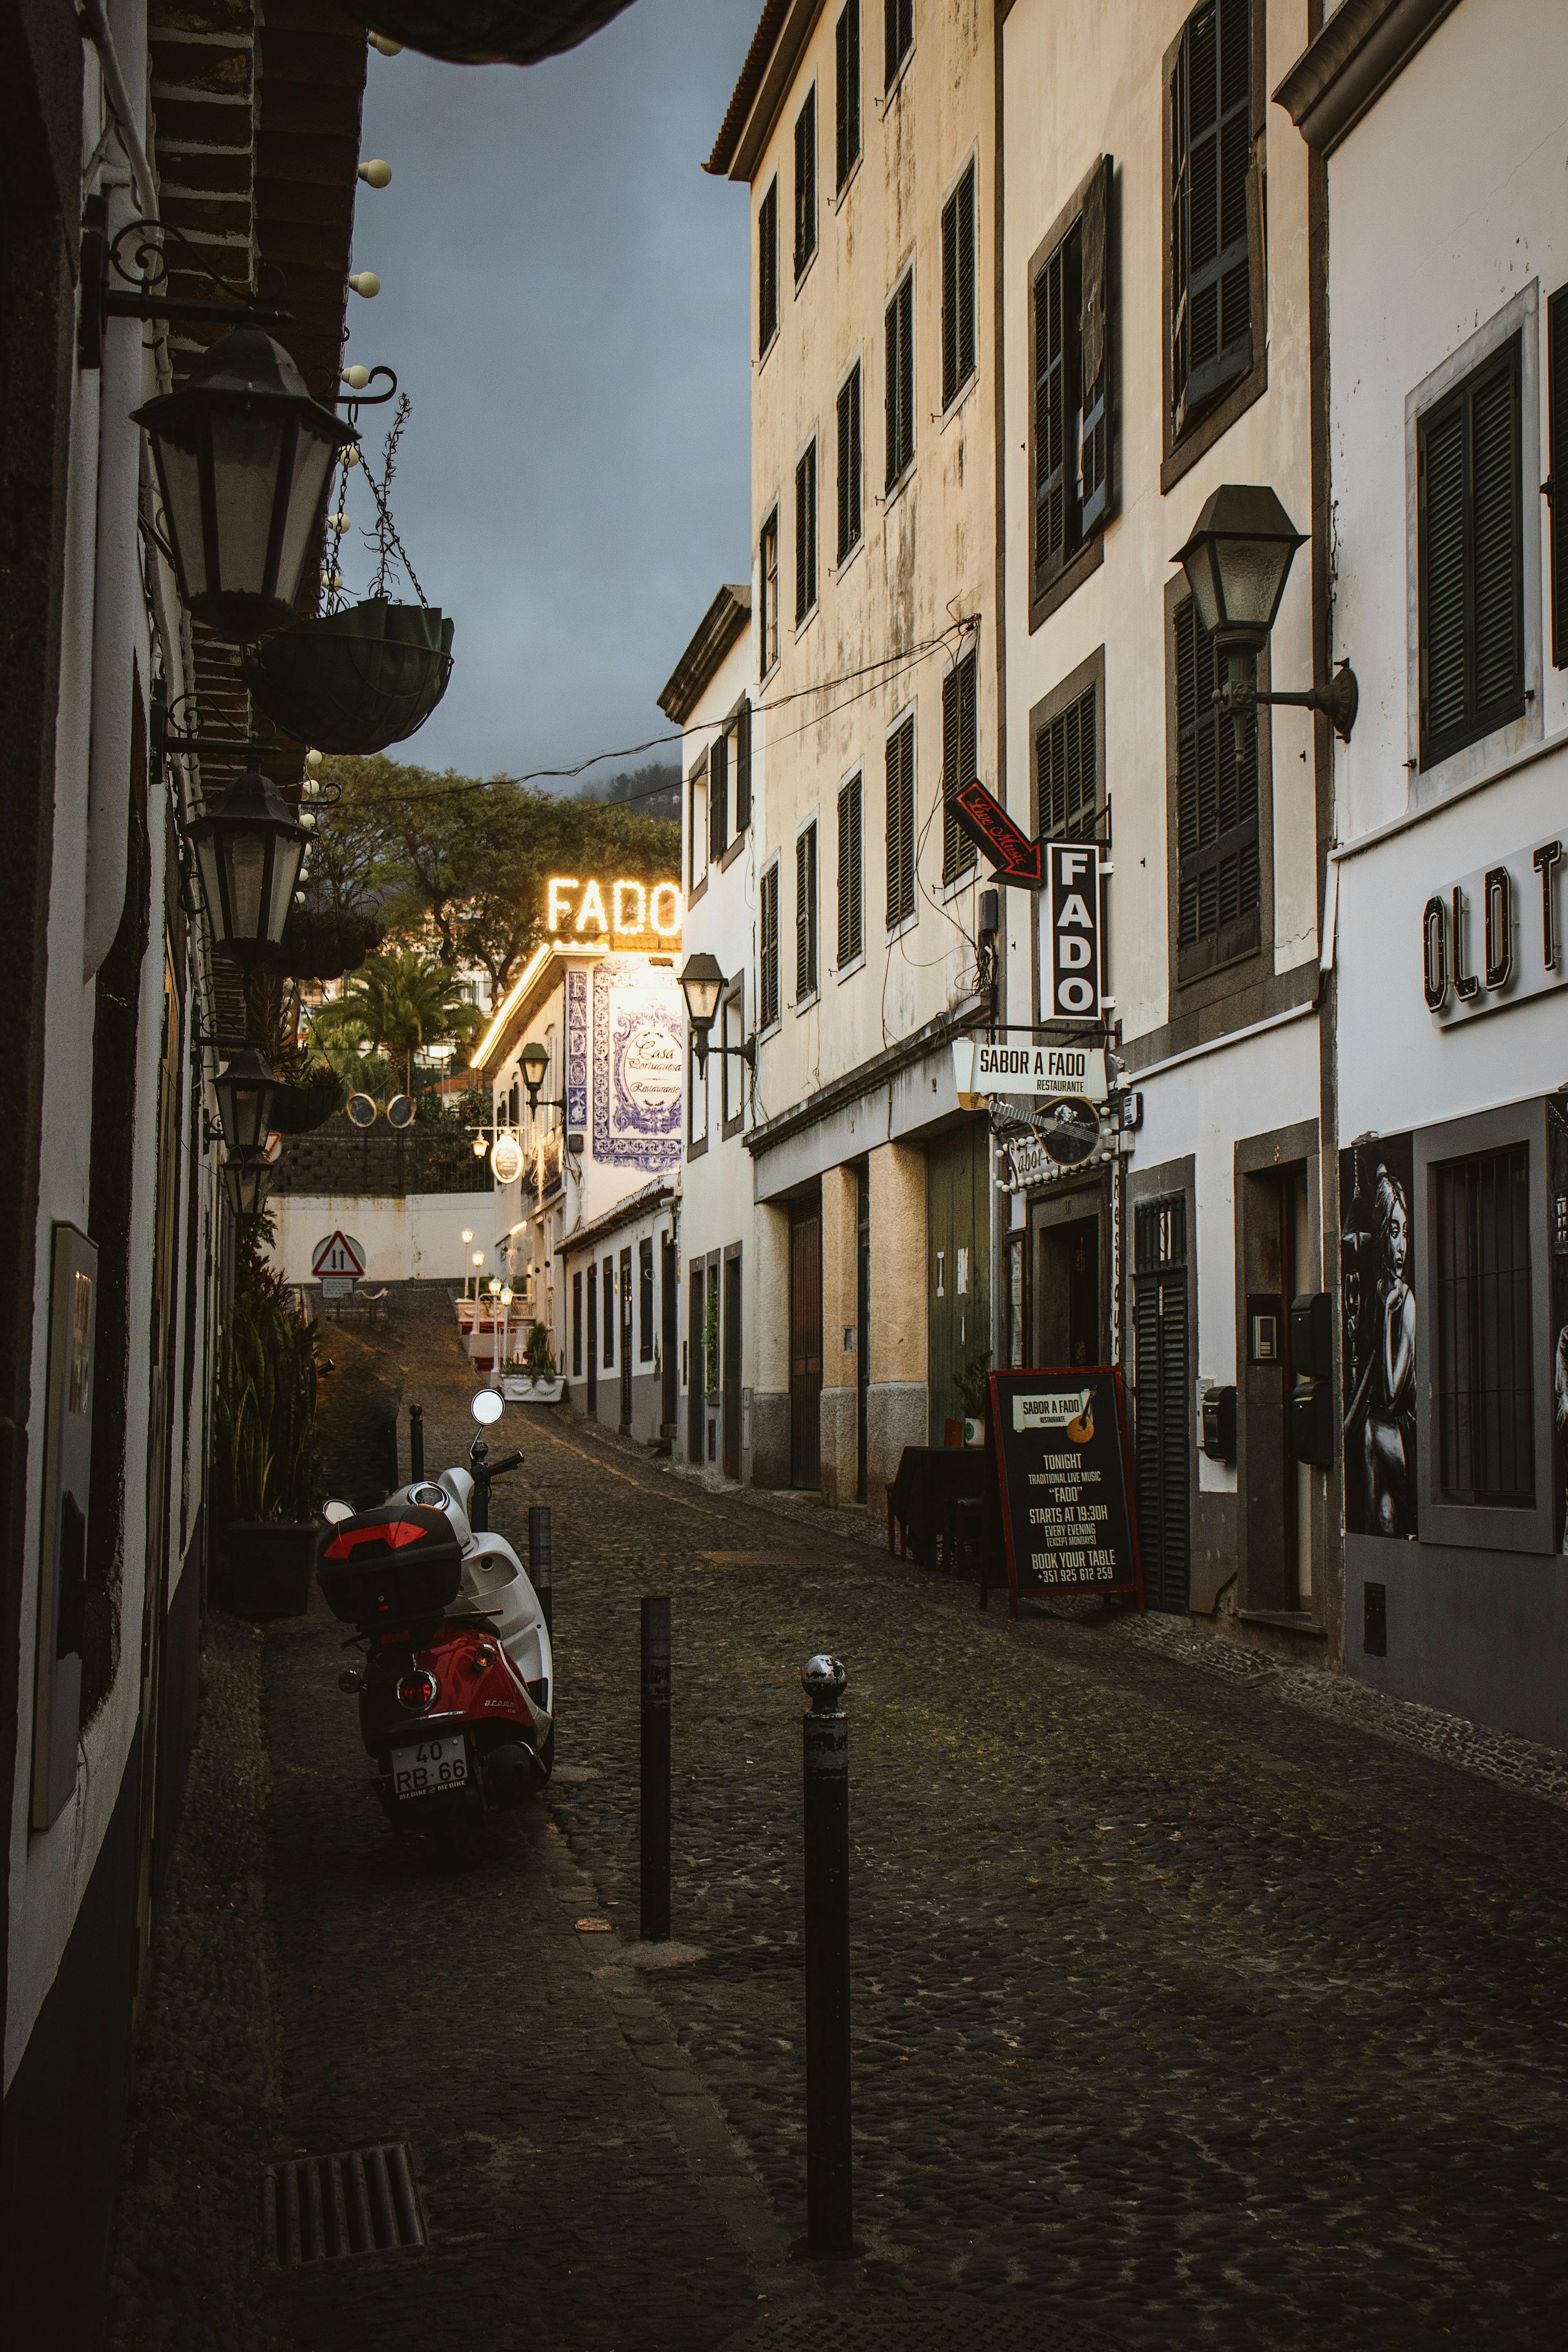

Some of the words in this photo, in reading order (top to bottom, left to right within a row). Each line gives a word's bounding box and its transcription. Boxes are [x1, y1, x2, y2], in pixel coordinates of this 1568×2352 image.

[967, 797, 994, 825] Live
[990, 827, 1026, 865] Music
[548, 877, 683, 936] FADO
[1057, 852, 1094, 1012] FADO
[1422, 865, 1512, 1014] OLD
[569, 973, 587, 1085] FADO
[635, 1039, 676, 1060] Casa
[627, 1057, 682, 1073] Portuguesa
[980, 1049, 1029, 1074] SABOR
[1034, 1052, 1043, 1075] A
[1049, 1053, 1085, 1076] FADO
[630, 1082, 680, 1093] Restaurante
[1037, 1080, 1084, 1092] RESTAURANTE
[1023, 1401, 1049, 1414] SABOR
[1052, 1400, 1057, 1413] A
[1059, 1400, 1079, 1413] FADO
[1043, 1453, 1082, 1470] TONIGHT
[1028, 1473, 1067, 1485] TRADITIONAL
[1067, 1472, 1080, 1483] LIVE
[1081, 1471, 1101, 1482] MUSIC
[1029, 1507, 1063, 1524] STARTS
[1064, 1506, 1074, 1522] AT
[1076, 1504, 1109, 1521] 19:30H
[1044, 1525, 1065, 1537] EVERY
[1067, 1523, 1096, 1536] EVENING
[1031, 1552, 1058, 1569] BOOK
[1059, 1551, 1086, 1568] YOUR
[1086, 1549, 1116, 1566] TABLE
[1038, 1569, 1058, 1583] +351
[1060, 1569, 1077, 1581] 925
[1079, 1567, 1095, 1581] 612
[1096, 1567, 1113, 1580] 259
[417, 1741, 442, 1763] 40
[411, 1789, 427, 1797] BIKE
